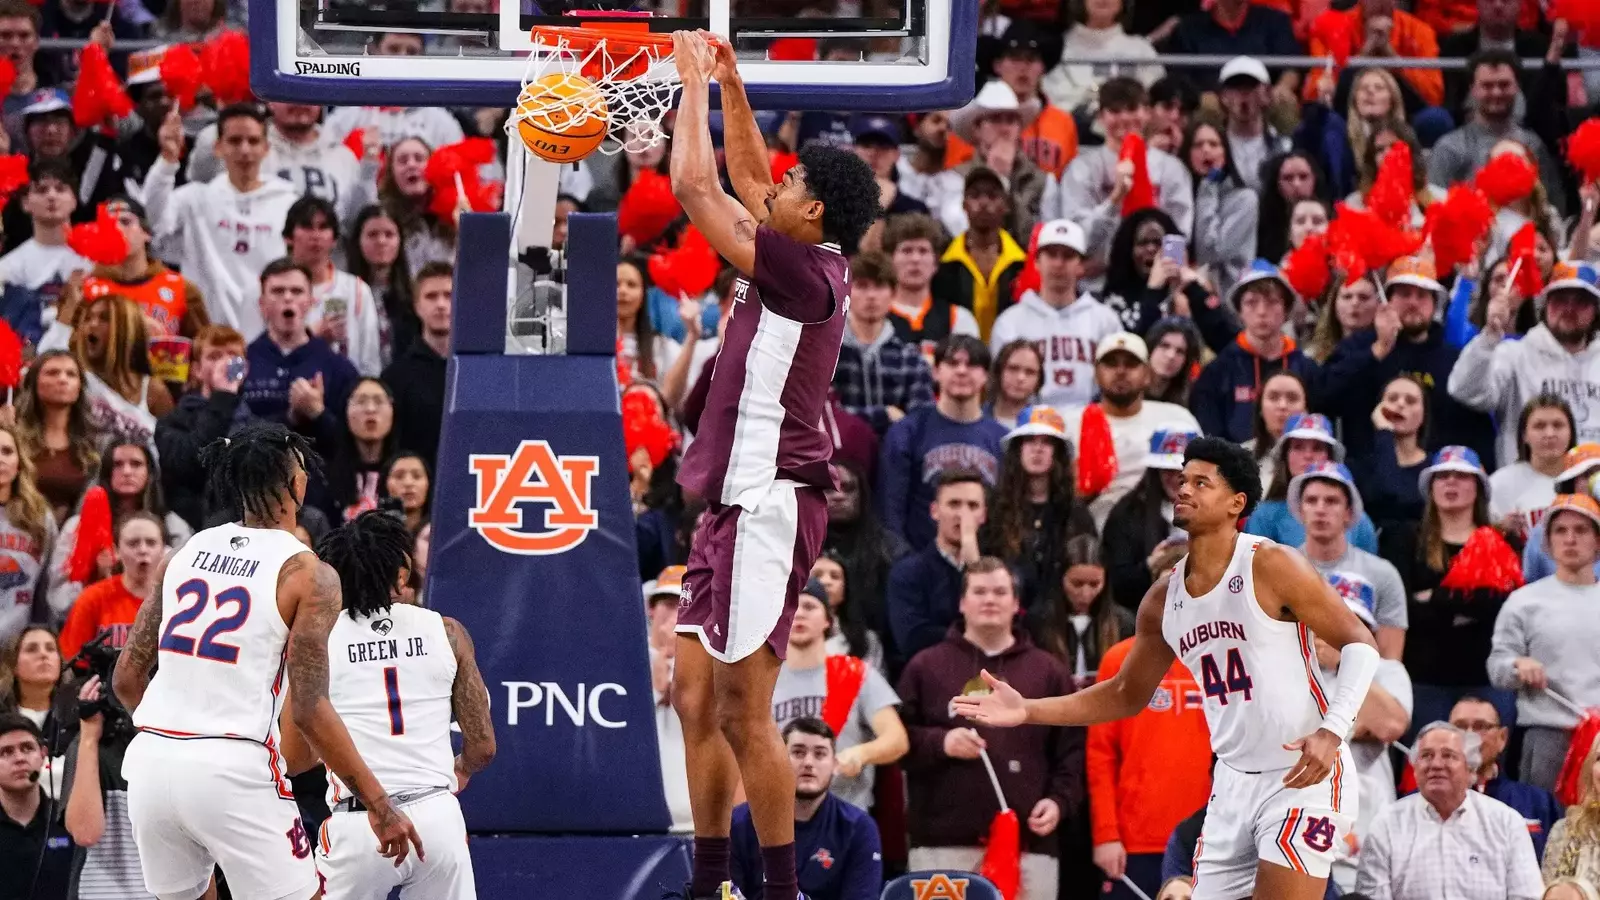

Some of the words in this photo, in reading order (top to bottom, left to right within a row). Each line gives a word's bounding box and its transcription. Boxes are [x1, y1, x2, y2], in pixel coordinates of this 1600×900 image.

[294, 61, 361, 77] SPALDING
[191, 551, 260, 578] FLANIGAN
[159, 577, 252, 665] 22
[1179, 620, 1248, 658] AUBURN
[347, 639, 399, 663] GREEN
[405, 636, 428, 657] JR.
[1200, 647, 1254, 706] 44
[383, 666, 405, 736] 1
[501, 681, 628, 728] PNC
